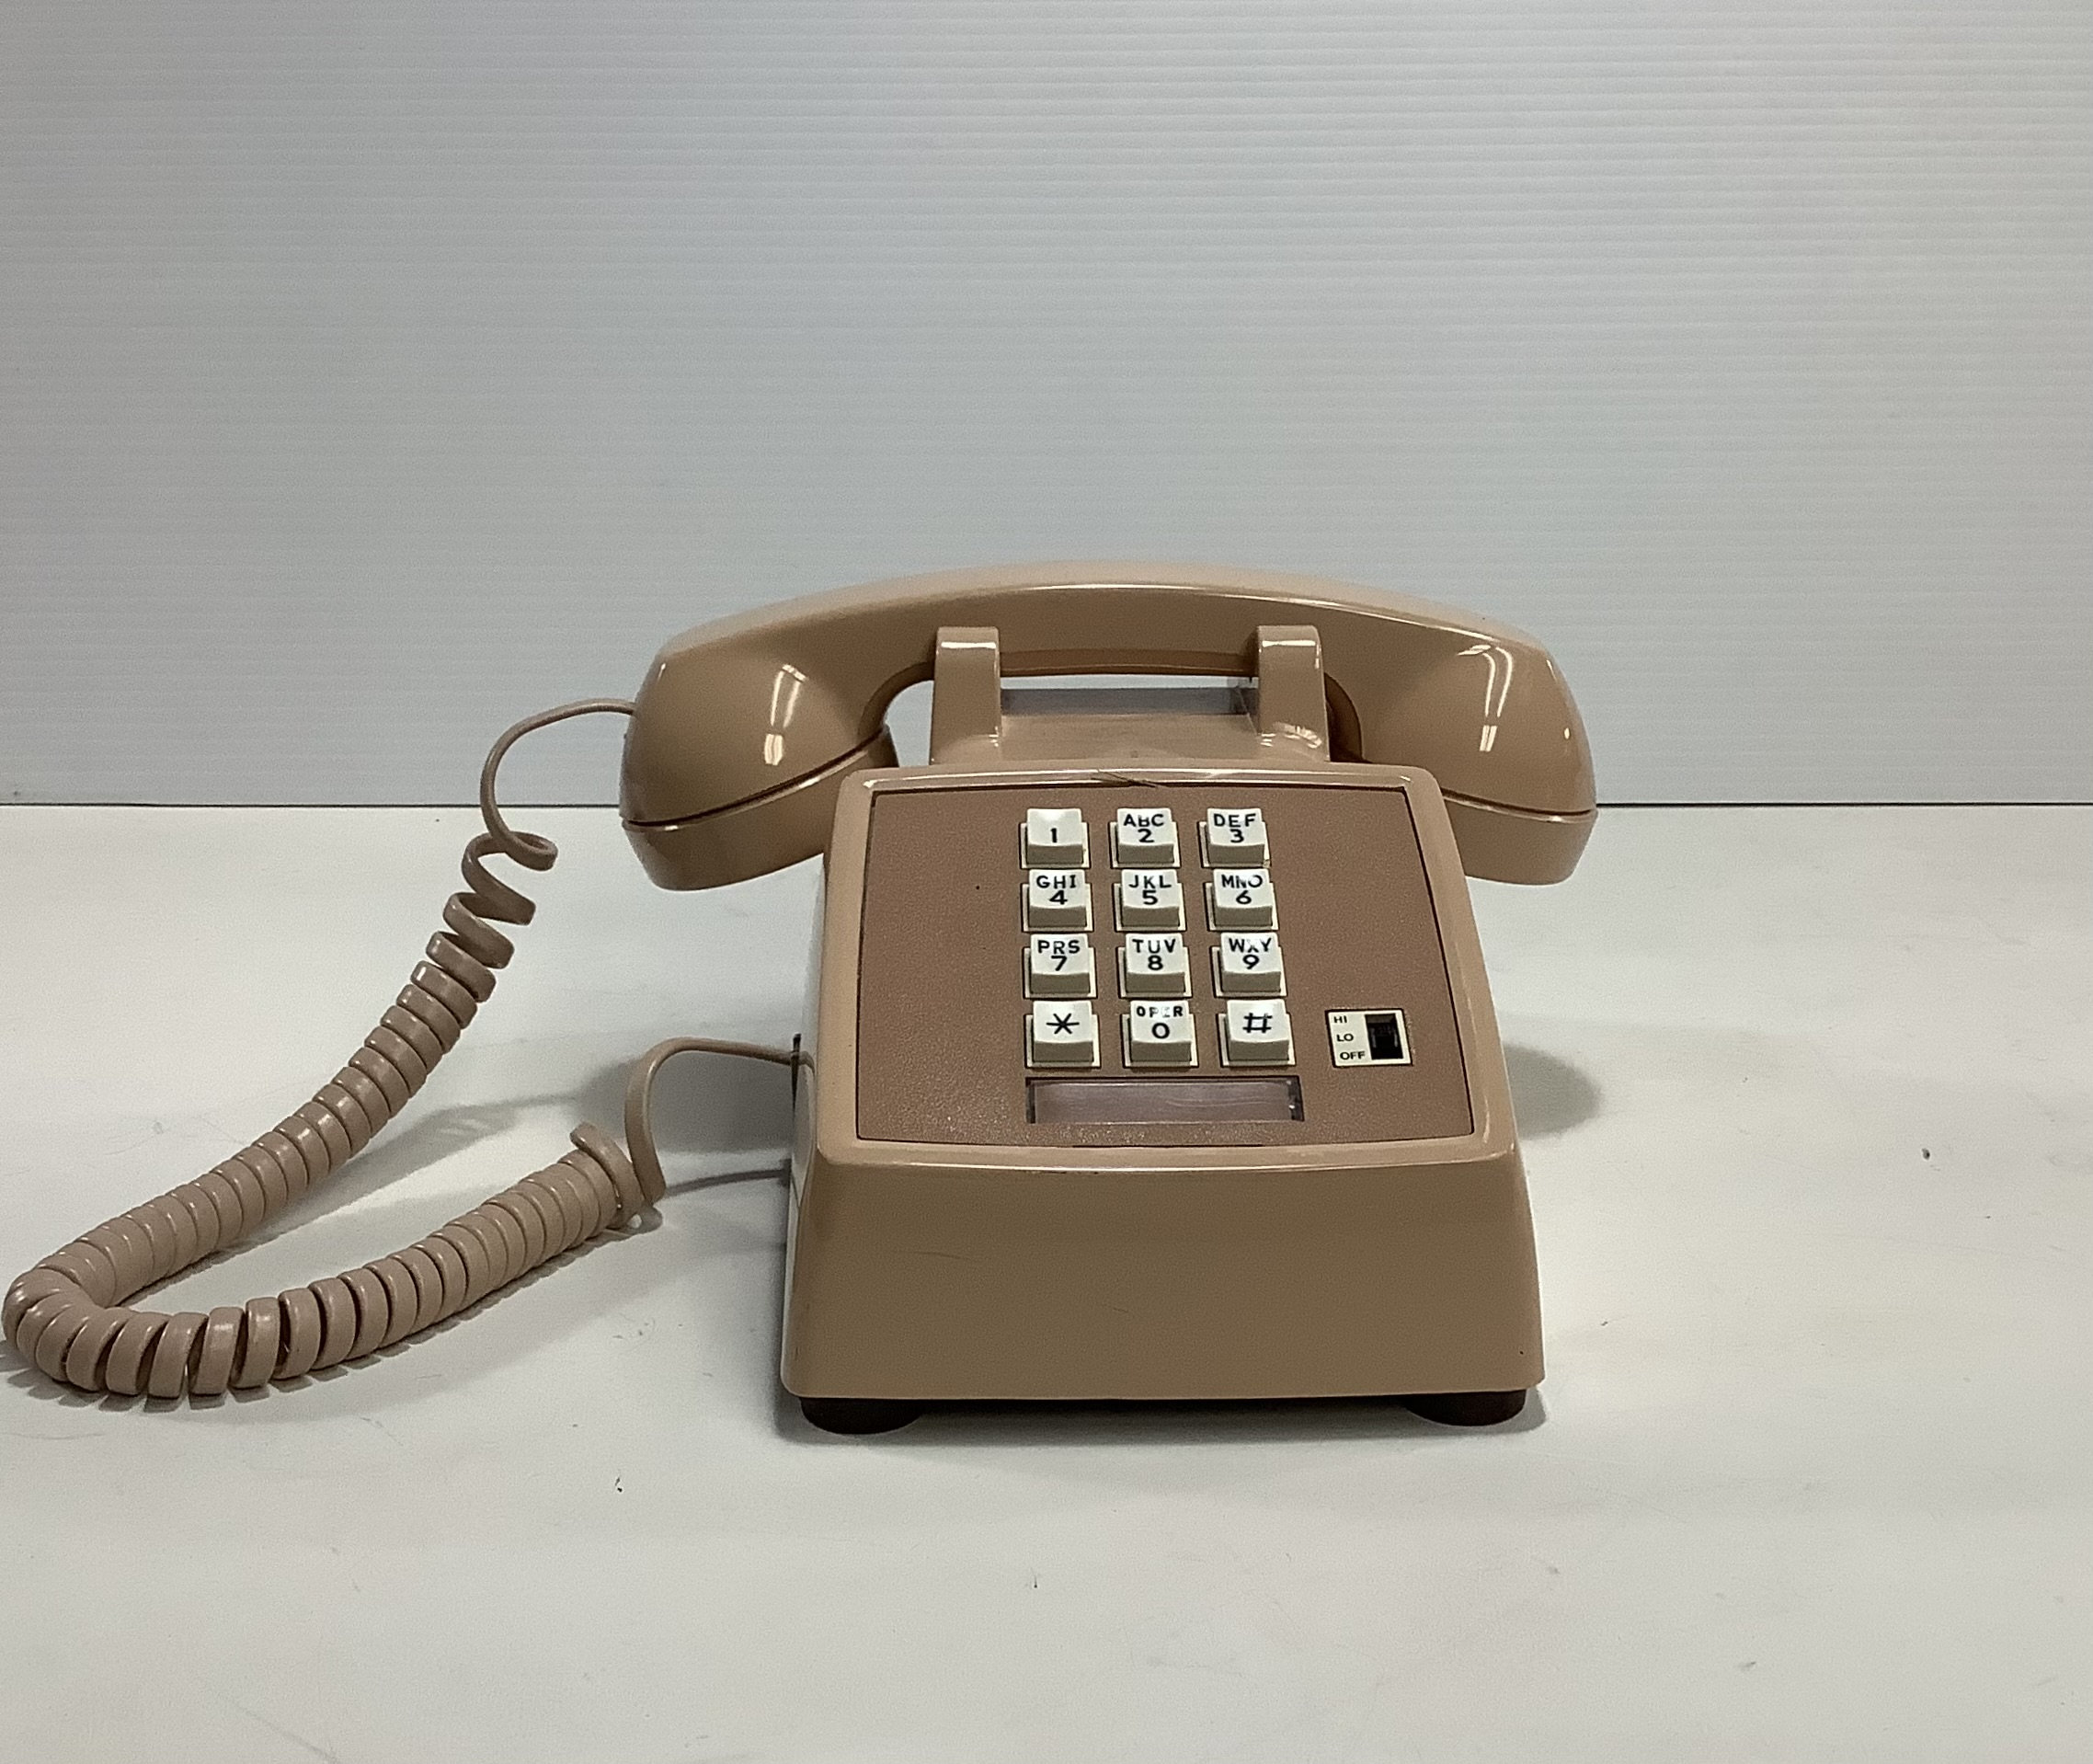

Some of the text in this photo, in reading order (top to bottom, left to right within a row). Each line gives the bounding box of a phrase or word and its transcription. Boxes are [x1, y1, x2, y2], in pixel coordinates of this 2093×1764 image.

[1213, 813, 1256, 828] DEF
[1050, 828, 1058, 843] 1
[1138, 829, 1154, 843] 2
[1229, 829, 1244, 843] 3
[1035, 875, 1077, 889] GHI
[1128, 875, 1172, 889] JKL
[1049, 890, 1068, 905] 4
[1142, 890, 1158, 905] 5
[1235, 890, 1252, 905] 6
[1037, 939, 1081, 955] PRS
[1132, 938, 1176, 954] TUV
[1052, 956, 1068, 971] 7
[1148, 955, 1163, 970] 8
[1242, 954, 1260, 969] 9
[1333, 1015, 1347, 1024] HI
[1336, 1033, 1354, 1042] LO
[1340, 1051, 1366, 1060] OFF
